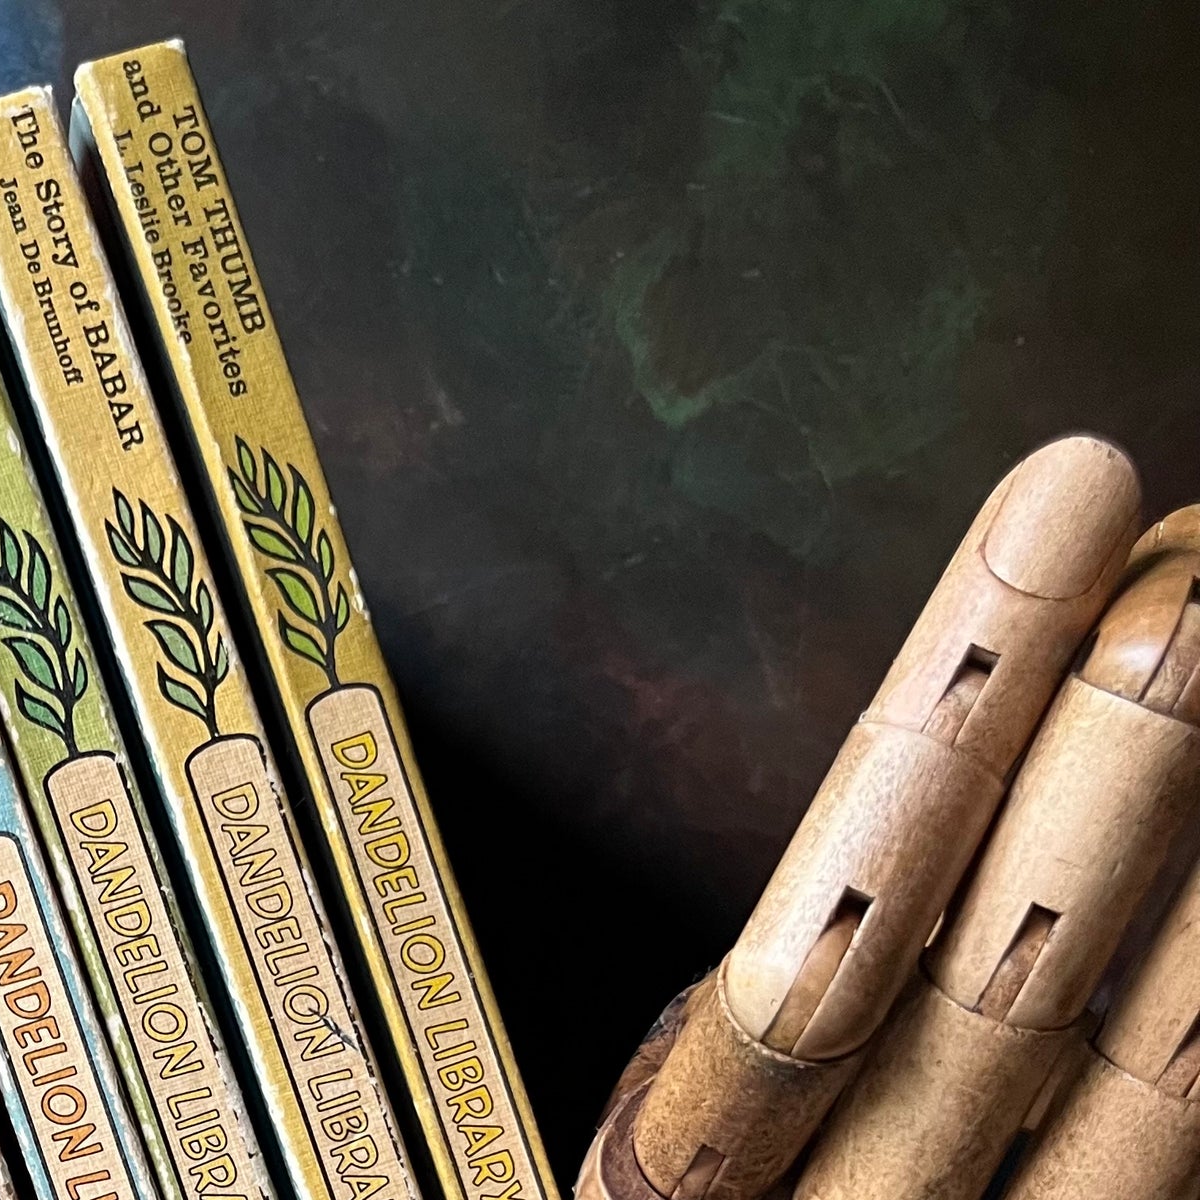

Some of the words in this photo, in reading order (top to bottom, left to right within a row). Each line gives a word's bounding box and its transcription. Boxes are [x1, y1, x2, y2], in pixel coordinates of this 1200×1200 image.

[10, 104, 46, 170] The
[31, 178, 81, 271] Story
[112, 129, 134, 157] L.
[123, 161, 163, 244] Leslie
[150, 247, 194, 346] Brooke
[121, 59, 162, 123] and
[146, 130, 195, 228] Other
[180, 236, 250, 398] Favorites
[171, 104, 219, 192] TOM
[202, 197, 267, 335] THUMB
[19, 239, 42, 275] De
[32, 277, 84, 387] Brunhoff
[68, 280, 100, 316] of
[81, 320, 145, 452] BABAR
[68, 798, 205, 1082] DANDELION
[210, 781, 346, 1063] DANDELION
[329, 730, 462, 1012] DANDELION
